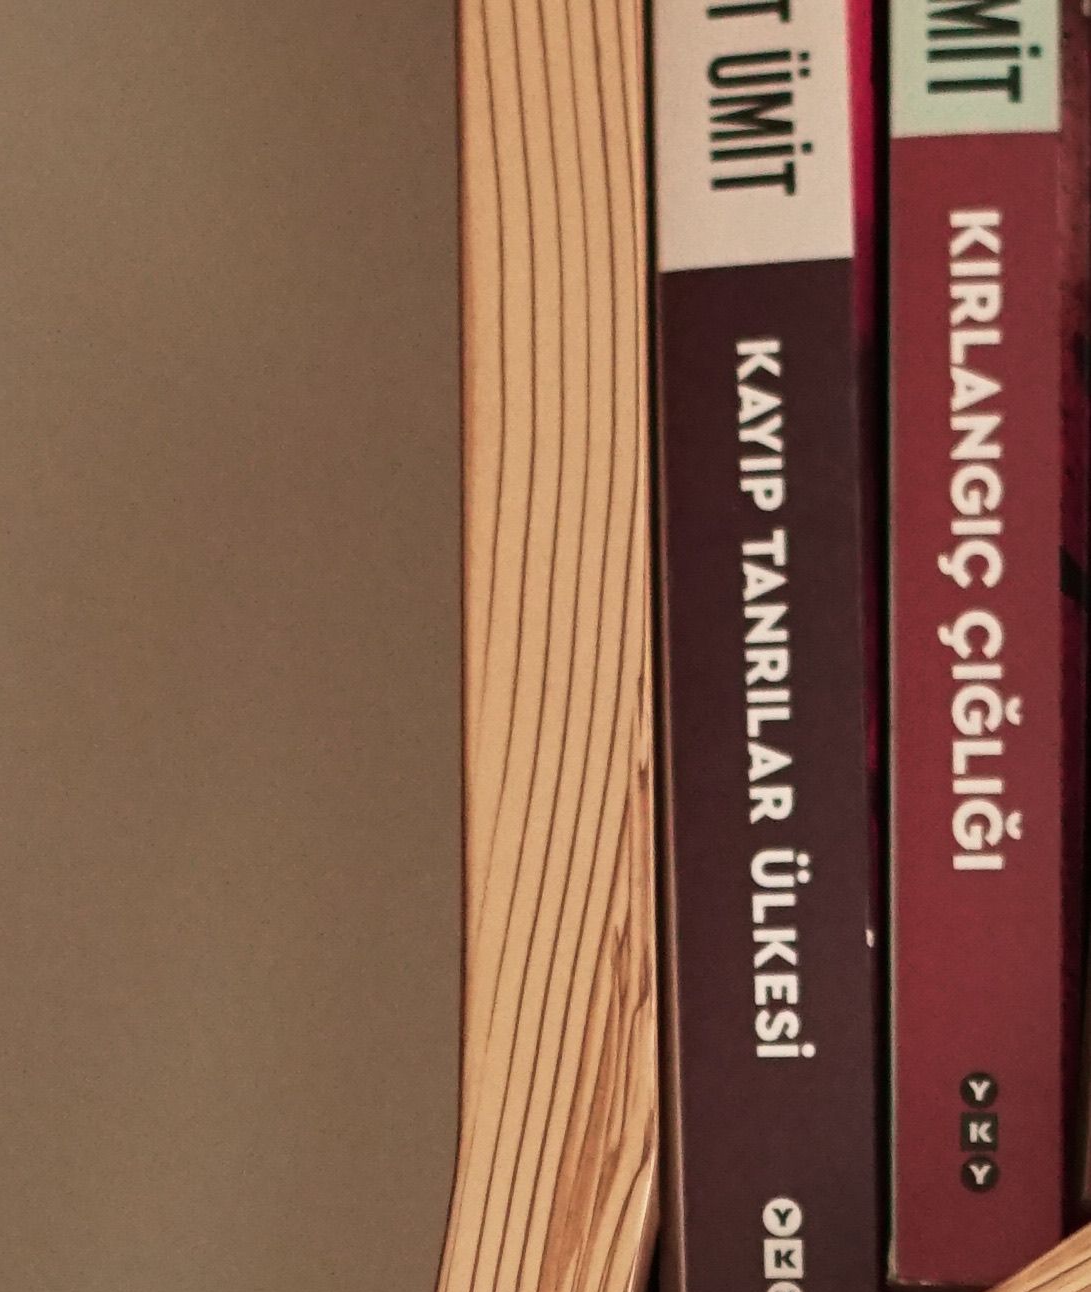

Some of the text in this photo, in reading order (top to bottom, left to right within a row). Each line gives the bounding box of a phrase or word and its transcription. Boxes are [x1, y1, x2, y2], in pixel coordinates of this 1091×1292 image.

[707, 50, 813, 196] ÜMİT
[736, 339, 817, 1058] KAYIP TANRILAR ÜLKESİ
[938, 208, 1023, 871] KIRLANGIÇ ÇIĞLIĞI
[964, 1075, 996, 1188] YKY
